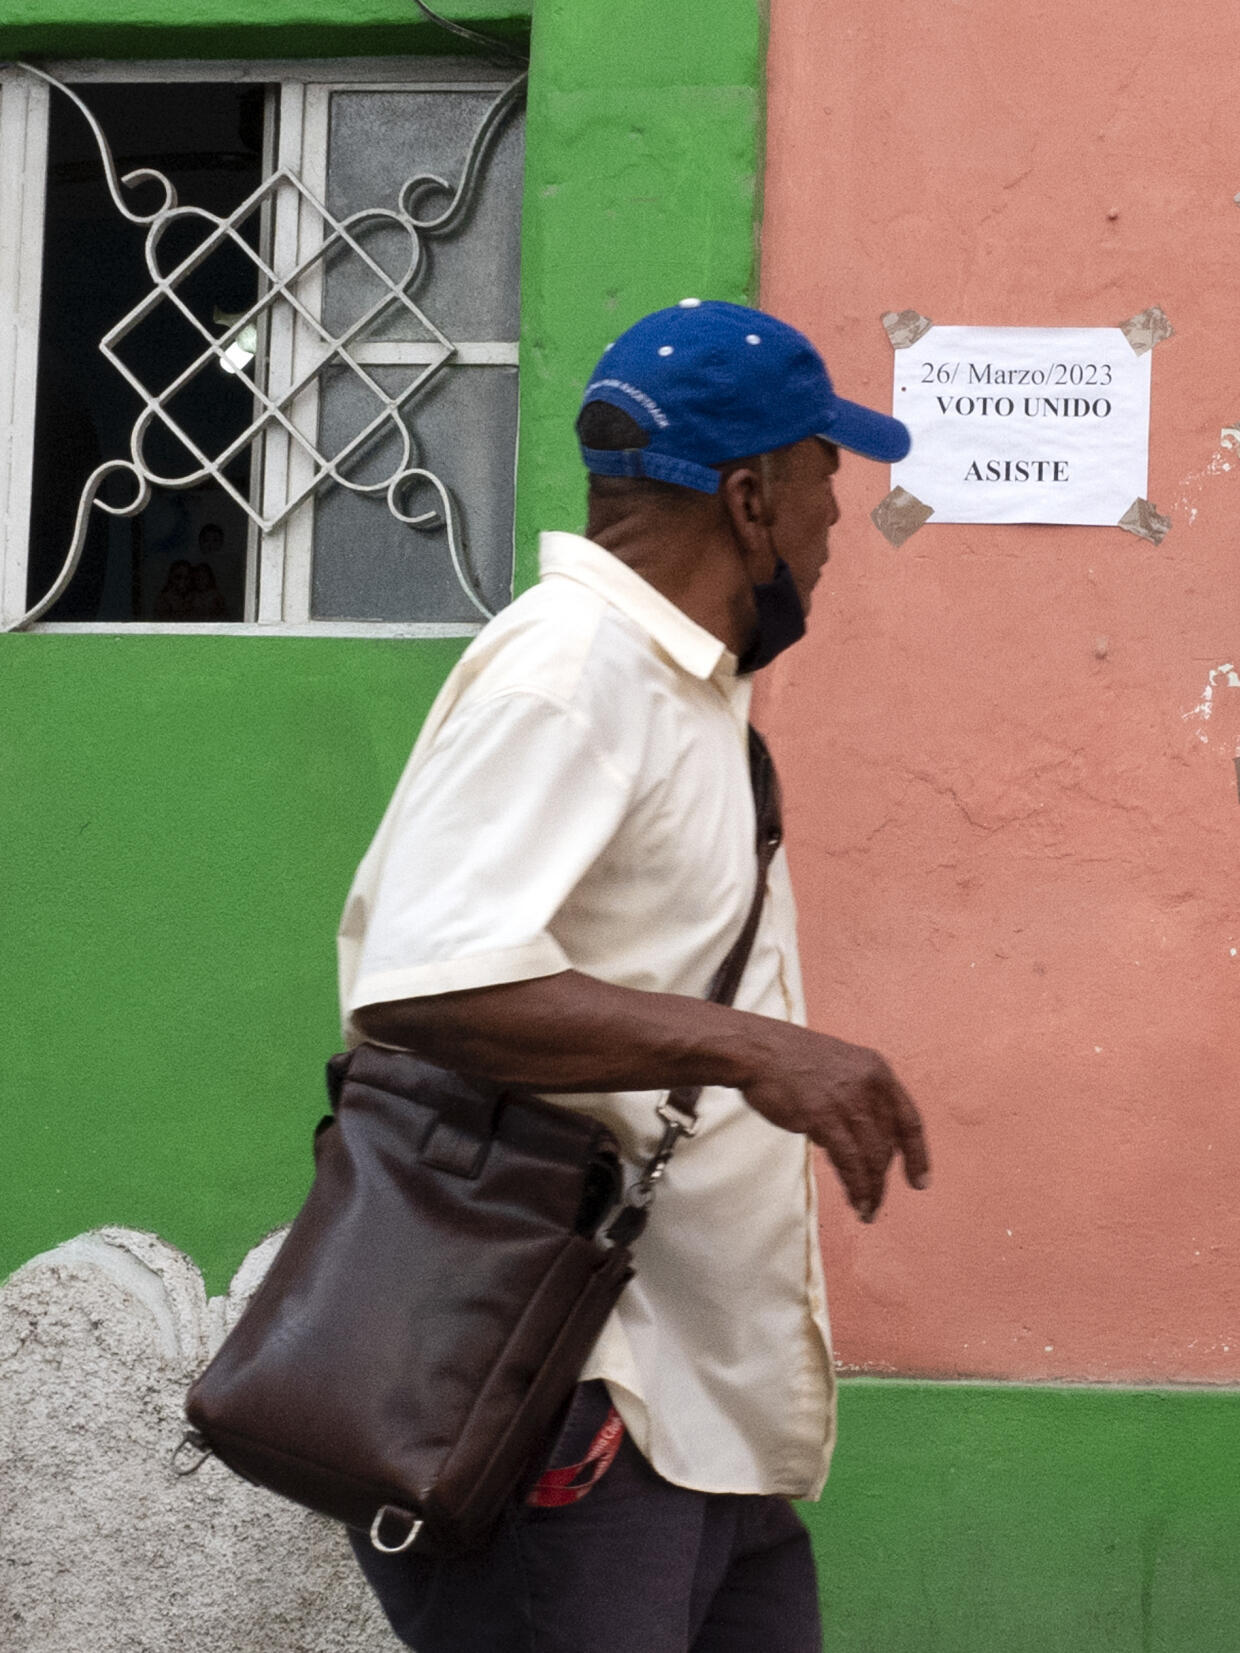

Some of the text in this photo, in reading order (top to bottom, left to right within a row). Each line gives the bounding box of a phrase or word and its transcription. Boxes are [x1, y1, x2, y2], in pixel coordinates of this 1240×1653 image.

[921, 362, 1113, 386] 26/ Marzo/2023
[936, 396, 1112, 418] VOTO UNIDO
[964, 460, 1069, 482] ASISTE
